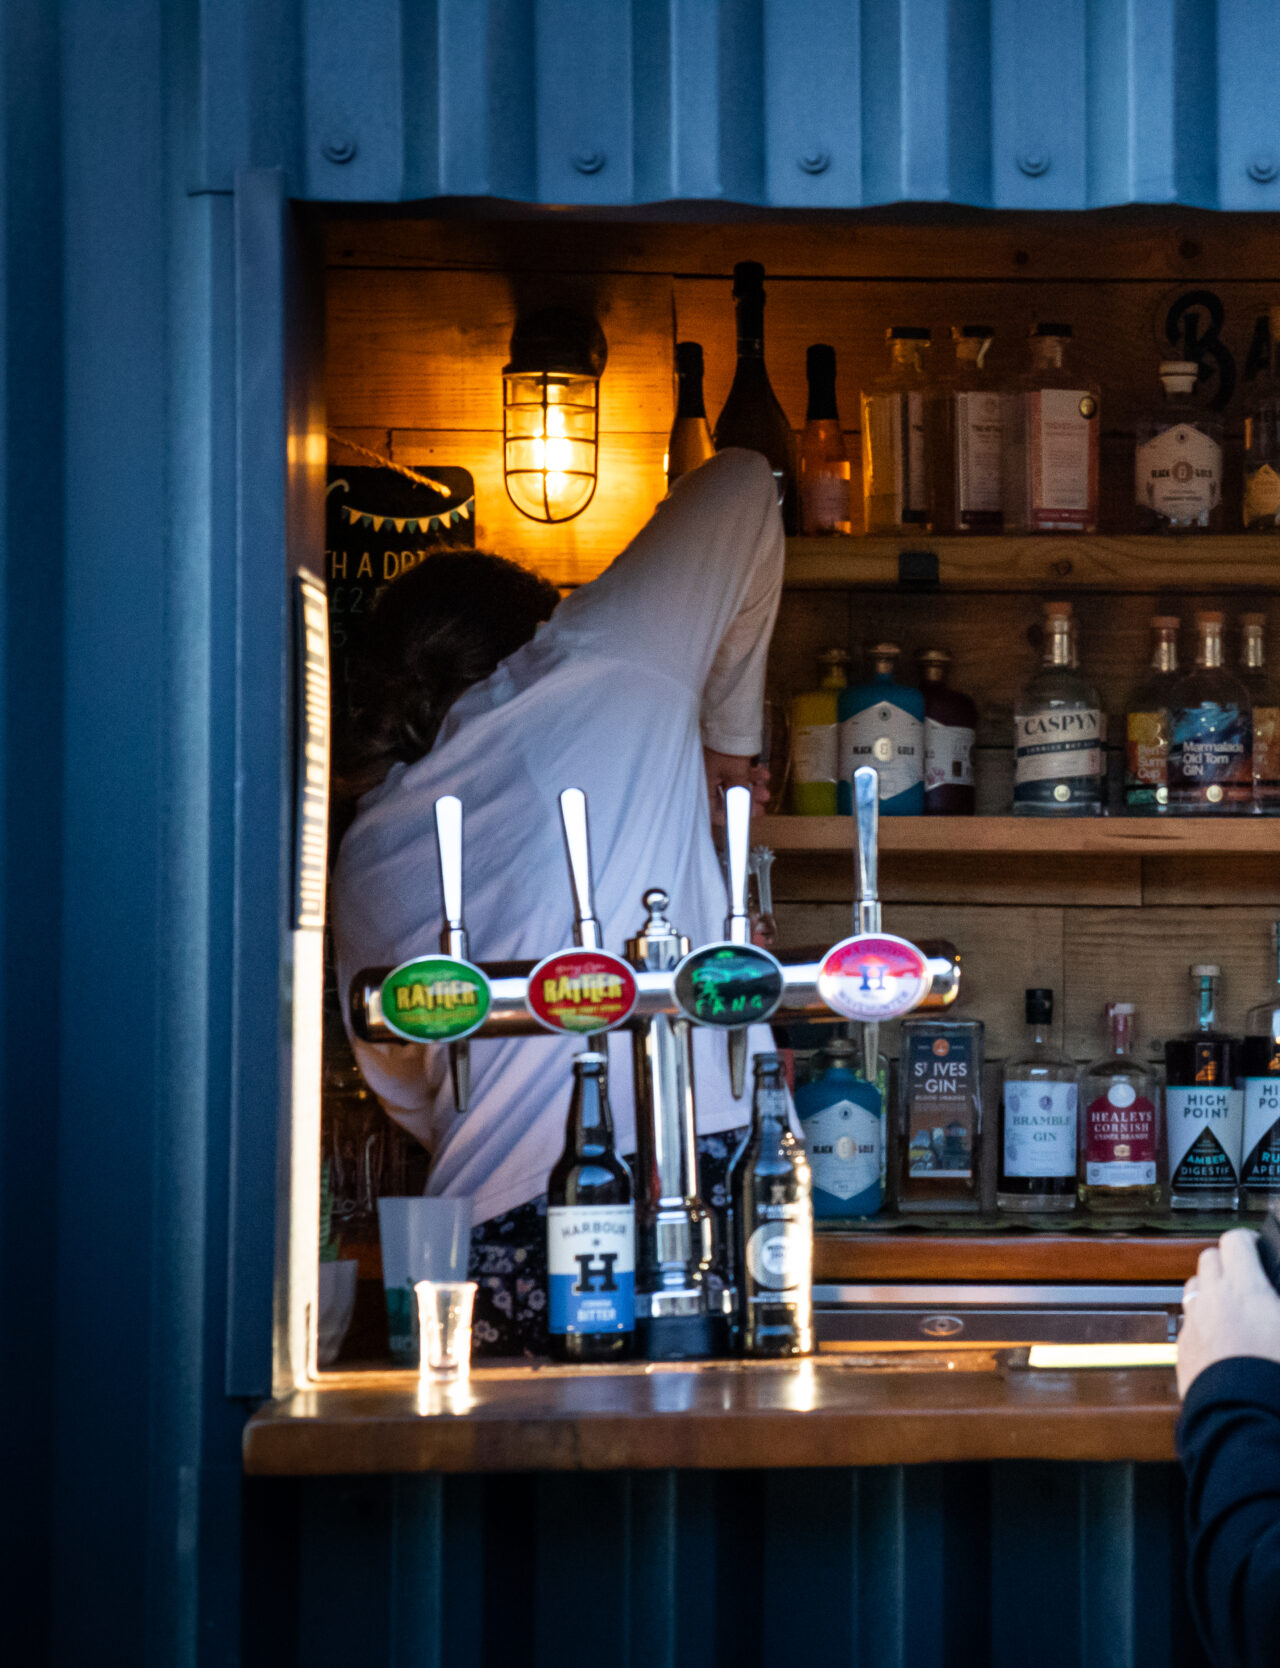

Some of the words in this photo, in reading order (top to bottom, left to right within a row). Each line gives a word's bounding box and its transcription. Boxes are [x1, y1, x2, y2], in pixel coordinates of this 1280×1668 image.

[356, 551, 374, 580] A
[1024, 712, 1097, 736] CASPYN
[852, 745, 872, 756] BLACK
[897, 745, 915, 756] GOLD
[1182, 753, 1203, 764] Old
[1203, 753, 1230, 764] Tom
[1182, 765, 1204, 777] GIN
[858, 964, 889, 991] H
[543, 973, 623, 1003] RATTLER
[396, 980, 478, 1011] RATTLER
[695, 994, 763, 1017] FANG
[933, 1062, 968, 1077] IVES
[924, 1078, 958, 1093] GIN
[1187, 1094, 1227, 1106] HIGH
[1091, 1111, 1153, 1123] HEALEYS
[1183, 1107, 1229, 1119] POINT
[1012, 1115, 1071, 1127] BRAMBLE
[1093, 1122, 1150, 1133] CORNISH
[1032, 1131, 1058, 1142] GIN
[812, 1144, 833, 1155] BLACK
[857, 1144, 875, 1154] GOLD
[1186, 1153, 1227, 1165] AMBER
[1180, 1166, 1231, 1176] DIGESTIF
[561, 1221, 628, 1239] HARBOUR
[574, 1252, 619, 1293] H
[576, 1308, 617, 1323] BITTER
